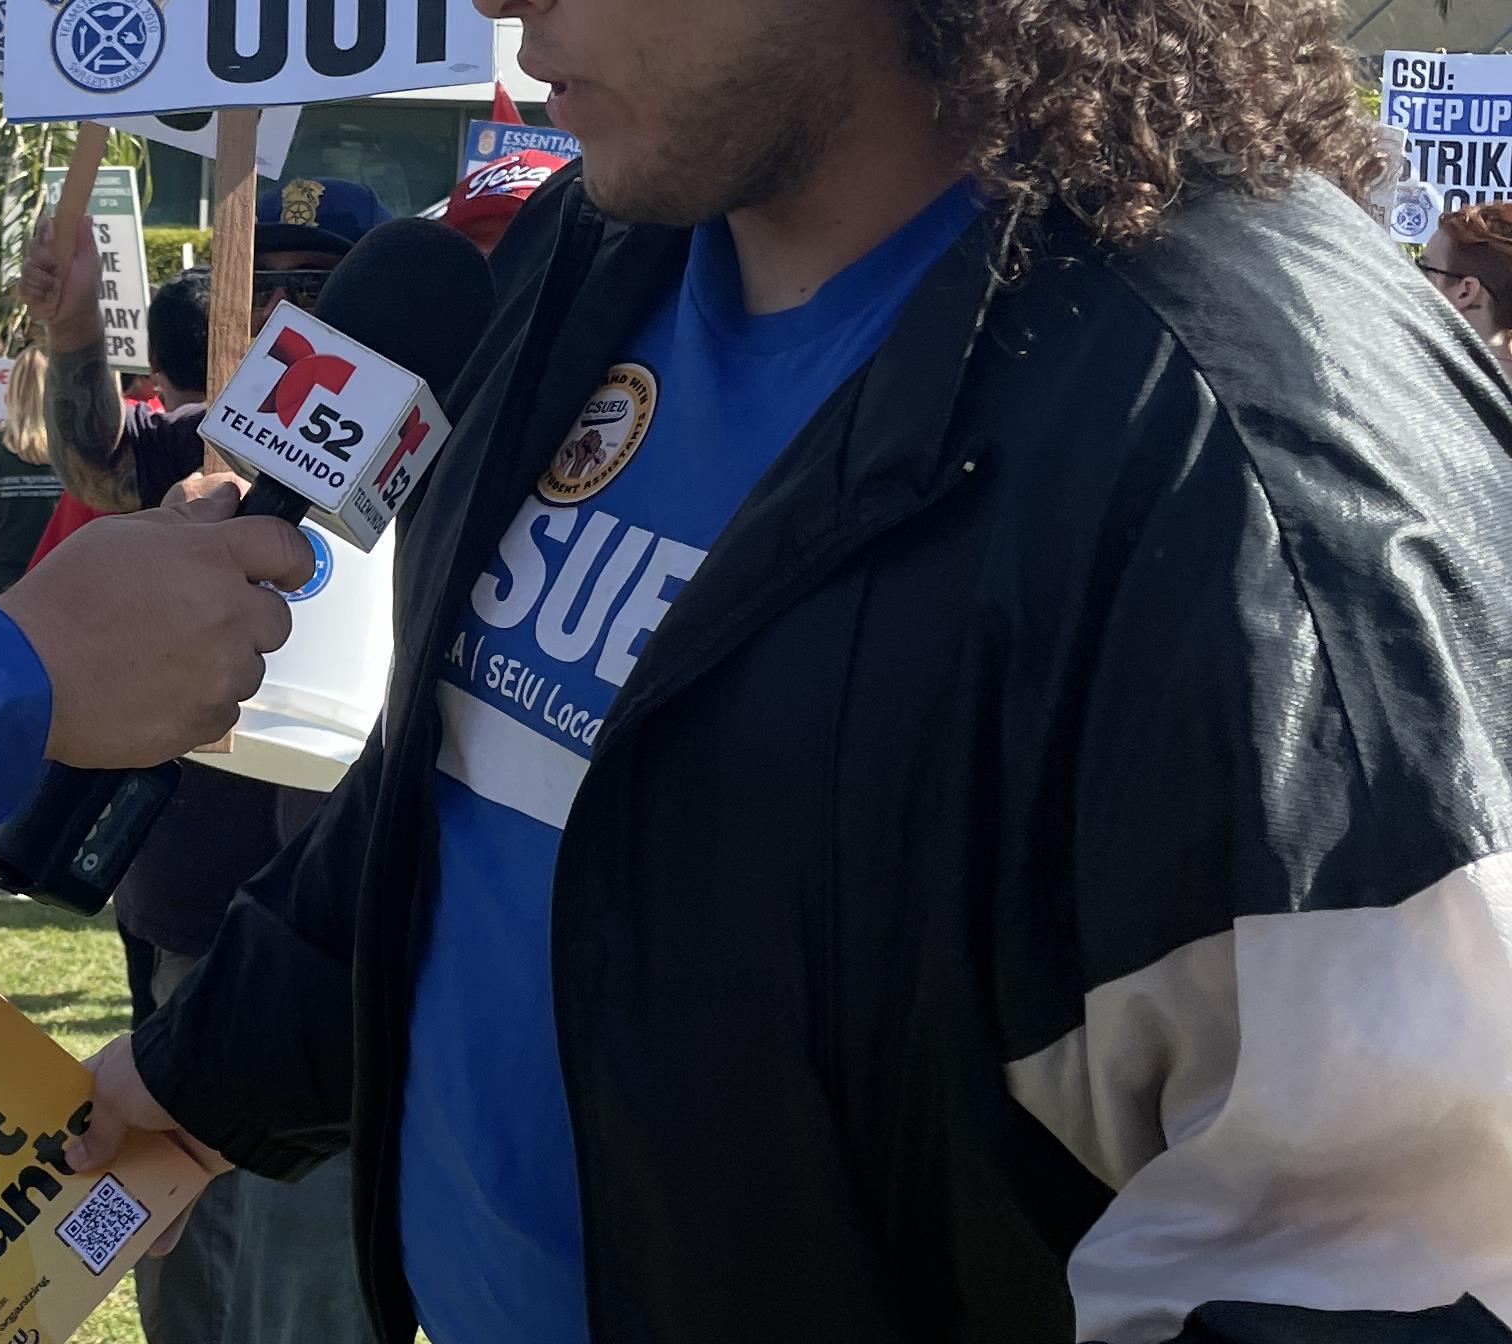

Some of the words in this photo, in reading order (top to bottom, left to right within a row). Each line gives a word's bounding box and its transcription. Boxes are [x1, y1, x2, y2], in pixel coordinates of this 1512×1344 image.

[1392, 58, 1454, 91] CSU:
[1391, 95, 1464, 132] STEP
[1469, 99, 1511, 134] UP
[466, 156, 553, 200] Texa
[1398, 139, 1512, 188] TRIK
[104, 309, 140, 330] ARY
[106, 336, 136, 357] EPS
[221, 406, 345, 488] TELEMUNDO
[299, 403, 364, 463] 52
[382, 466, 411, 510] 52
[544, 472, 580, 494] TUDENT
[352, 488, 387, 535] TELEMUNDO
[471, 495, 708, 687] SUE
[486, 654, 545, 711] SEIU
[543, 683, 605, 746] Loca
